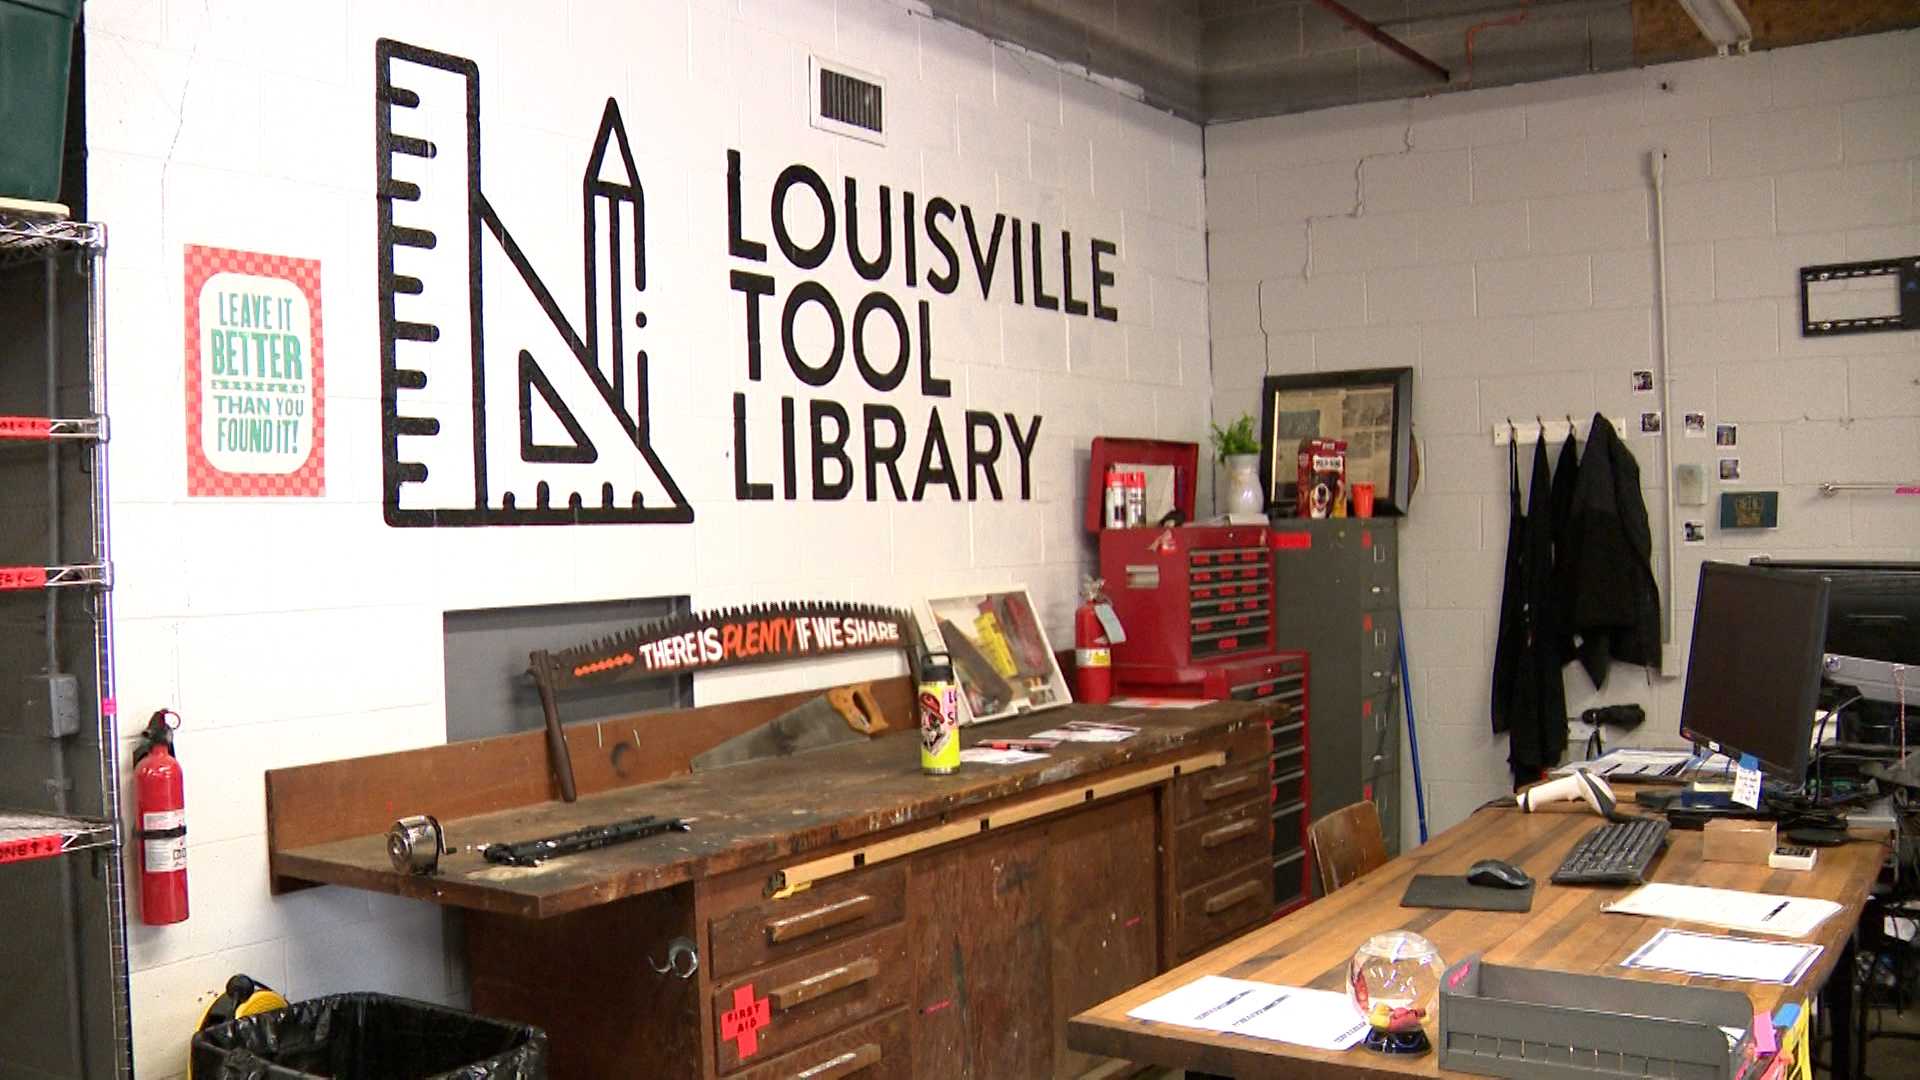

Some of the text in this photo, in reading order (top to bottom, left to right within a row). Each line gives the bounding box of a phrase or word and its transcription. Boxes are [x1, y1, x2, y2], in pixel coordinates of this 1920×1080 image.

[727, 149, 1118, 322] LOUISVILLE
[219, 292, 293, 331] LEAVE IT
[730, 269, 951, 397] TOOL
[210, 328, 304, 380] BETTER
[213, 395, 304, 417] THAN YOU
[217, 417, 299, 454] FOUND IT!
[733, 392, 1042, 502] LIBRARY
[639, 617, 899, 669] THERE IS PLENTY IF WE SHARE
[727, 1003, 760, 1023] FIRST
[737, 1017, 757, 1033] AID
